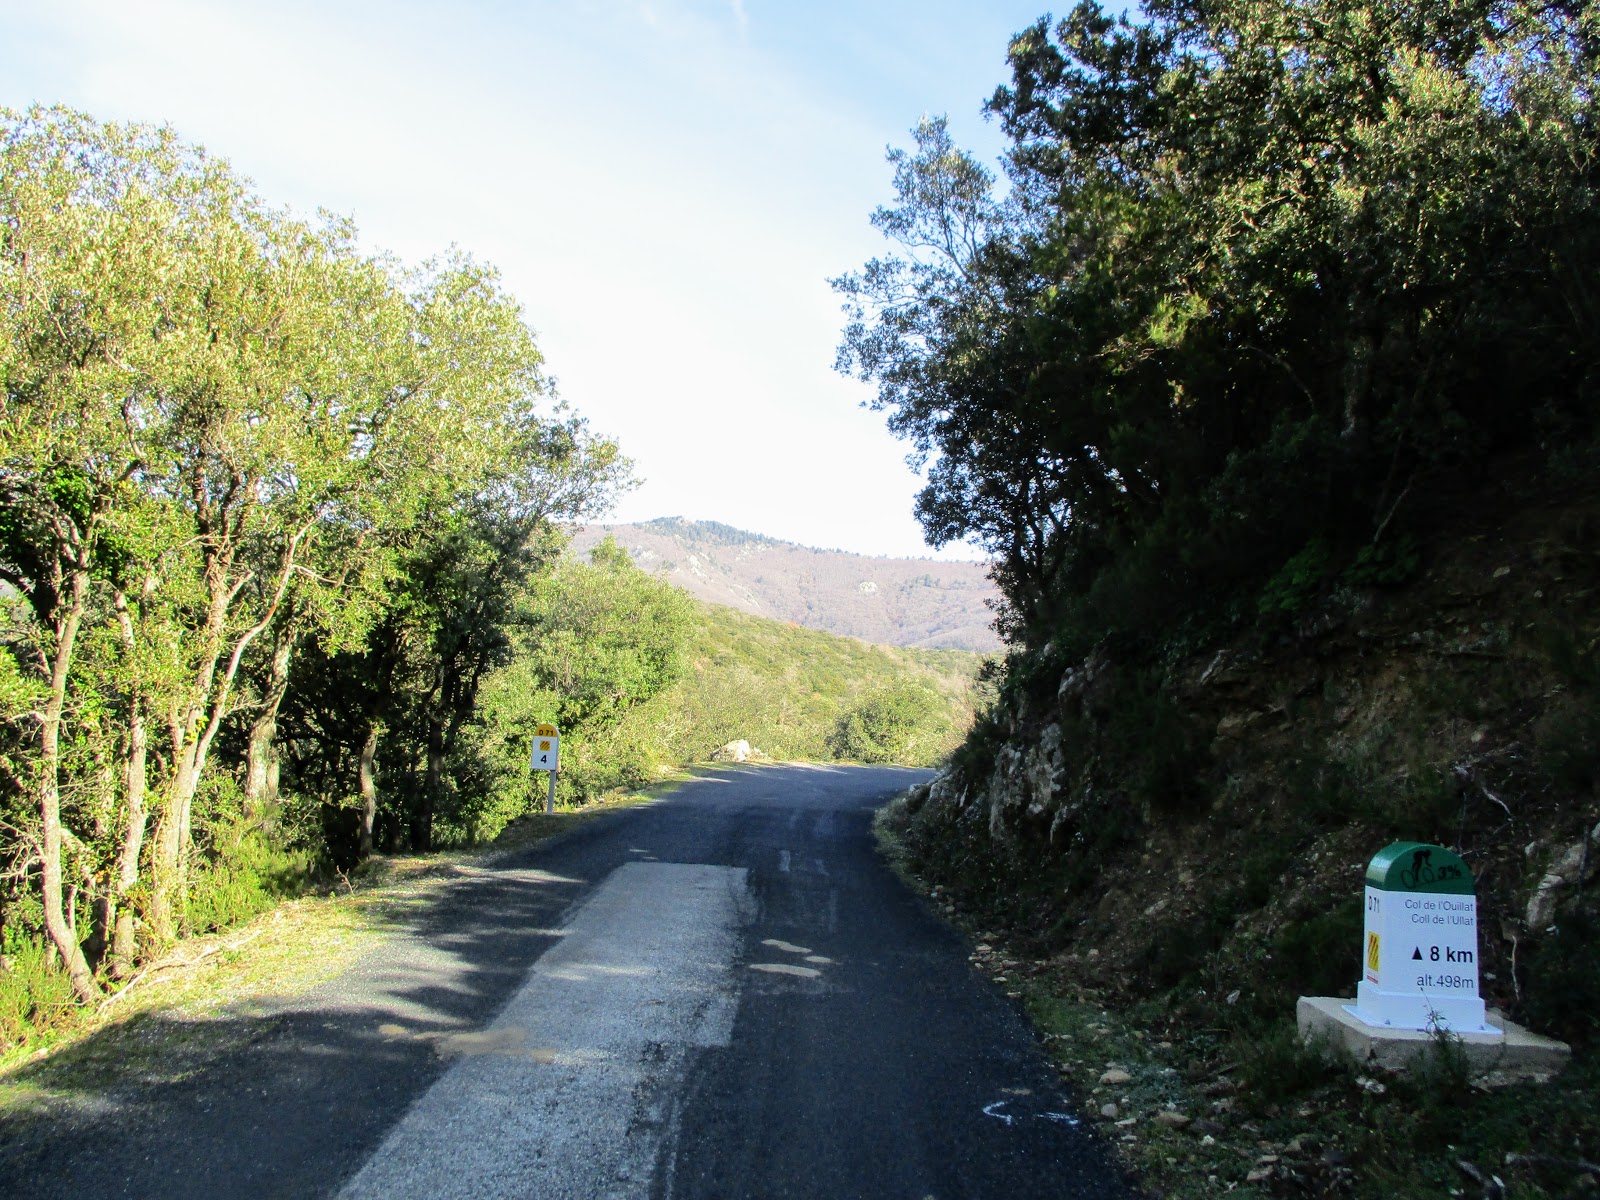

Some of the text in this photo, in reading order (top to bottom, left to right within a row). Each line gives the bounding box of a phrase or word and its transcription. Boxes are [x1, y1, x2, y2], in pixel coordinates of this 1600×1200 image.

[540, 754, 547, 764] 4
[1438, 865, 1462, 880] 3%
[1404, 899, 1474, 912] Col de l'Ouillat
[1411, 913, 1474, 926] Coll de l'Ullat
[1429, 946, 1473, 963] 8 km
[1416, 974, 1474, 989] alt.498m
